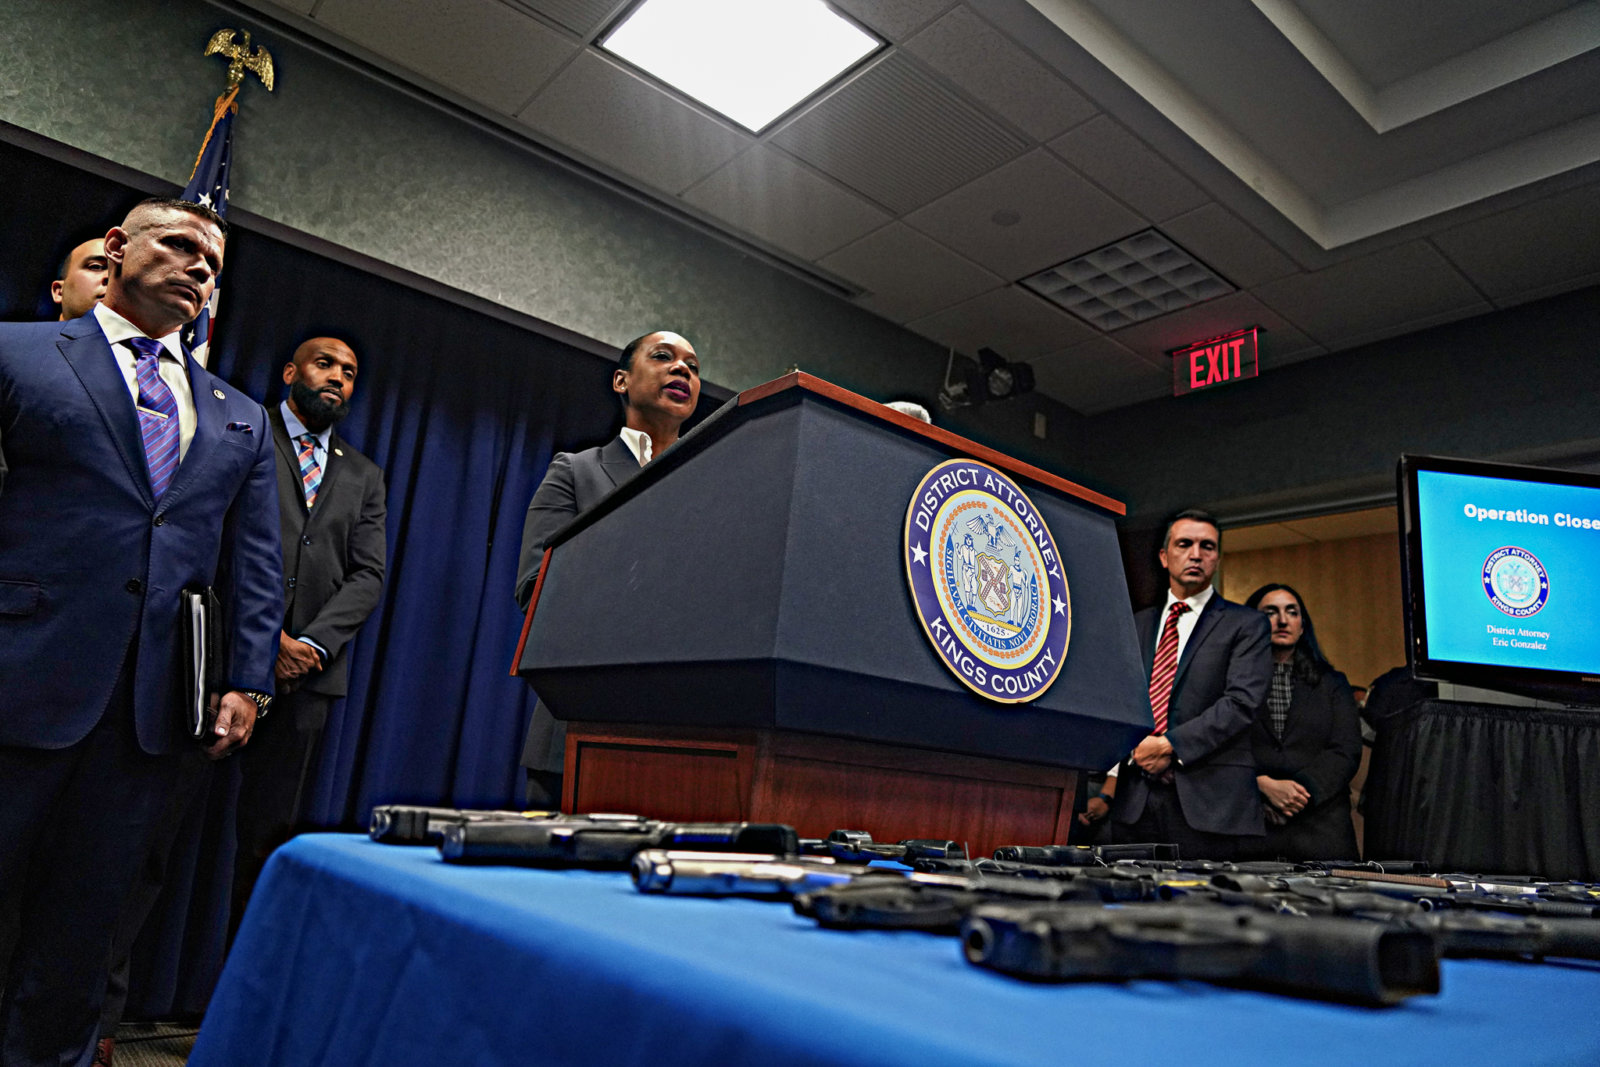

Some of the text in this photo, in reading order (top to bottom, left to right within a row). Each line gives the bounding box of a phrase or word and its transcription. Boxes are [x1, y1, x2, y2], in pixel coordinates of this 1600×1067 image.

[1190, 338, 1245, 389] EXIT
[915, 468, 1061, 580] DISTRICT ATTORNEY
[1464, 503, 1600, 530] Operation Close
[1484, 548, 1545, 579] DISTRICT ATTORNEY
[1491, 595, 1543, 616] KINGS COUNTY
[985, 624, 1006, 637] 1625
[1009, 631, 1030, 649] NOVI
[1487, 625, 1551, 640] District Attorney
[930, 616, 1057, 695] KINGS COUNTY
[1492, 637, 1547, 650] Eric Gonzalez
